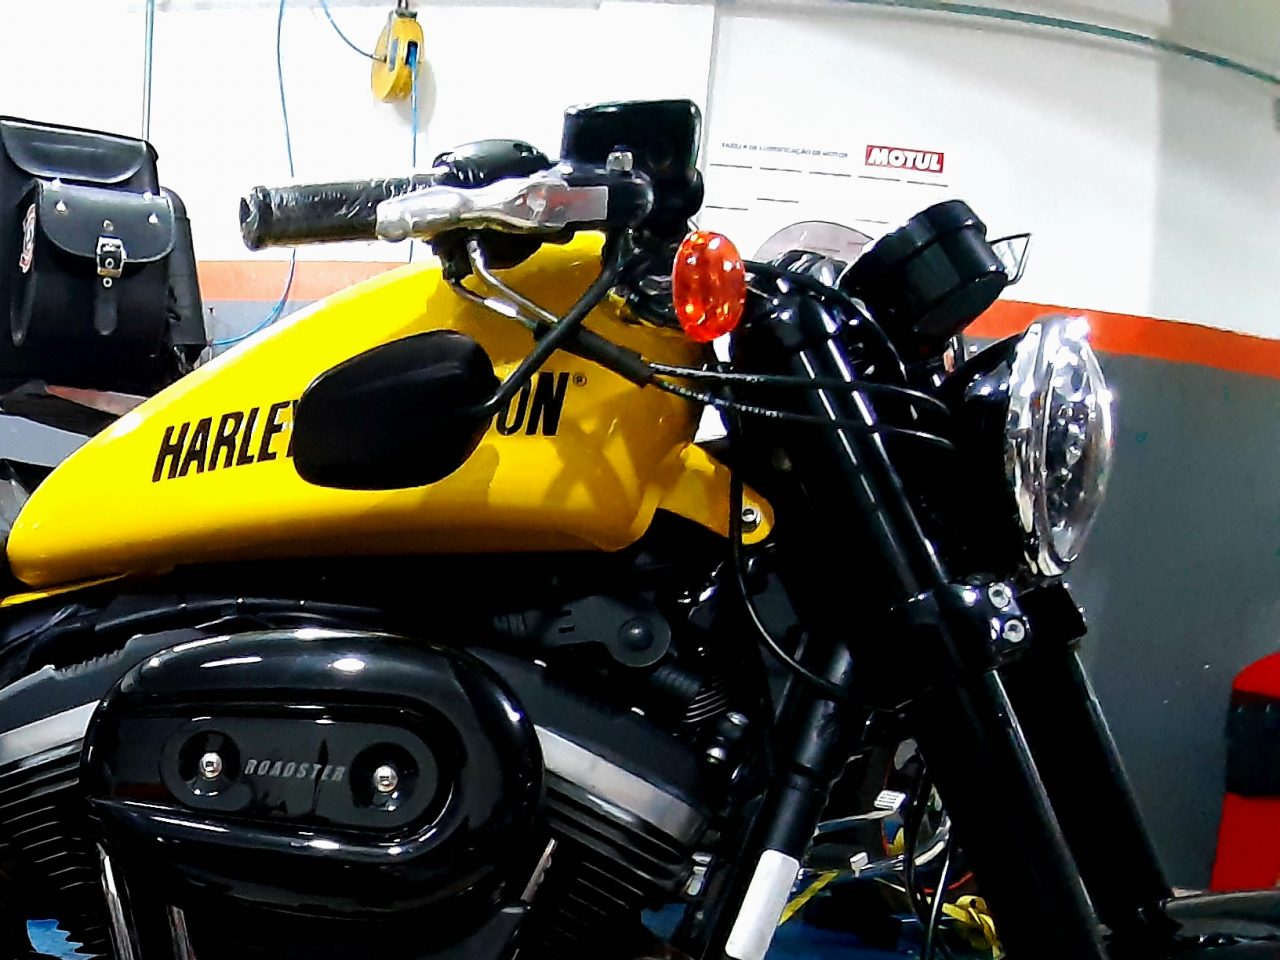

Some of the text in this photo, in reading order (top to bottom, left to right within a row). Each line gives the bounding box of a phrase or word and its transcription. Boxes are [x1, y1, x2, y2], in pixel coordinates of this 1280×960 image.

[867, 147, 942, 172] MOTUL
[152, 399, 299, 483] HARLE
[244, 758, 348, 782] ROADSTER
